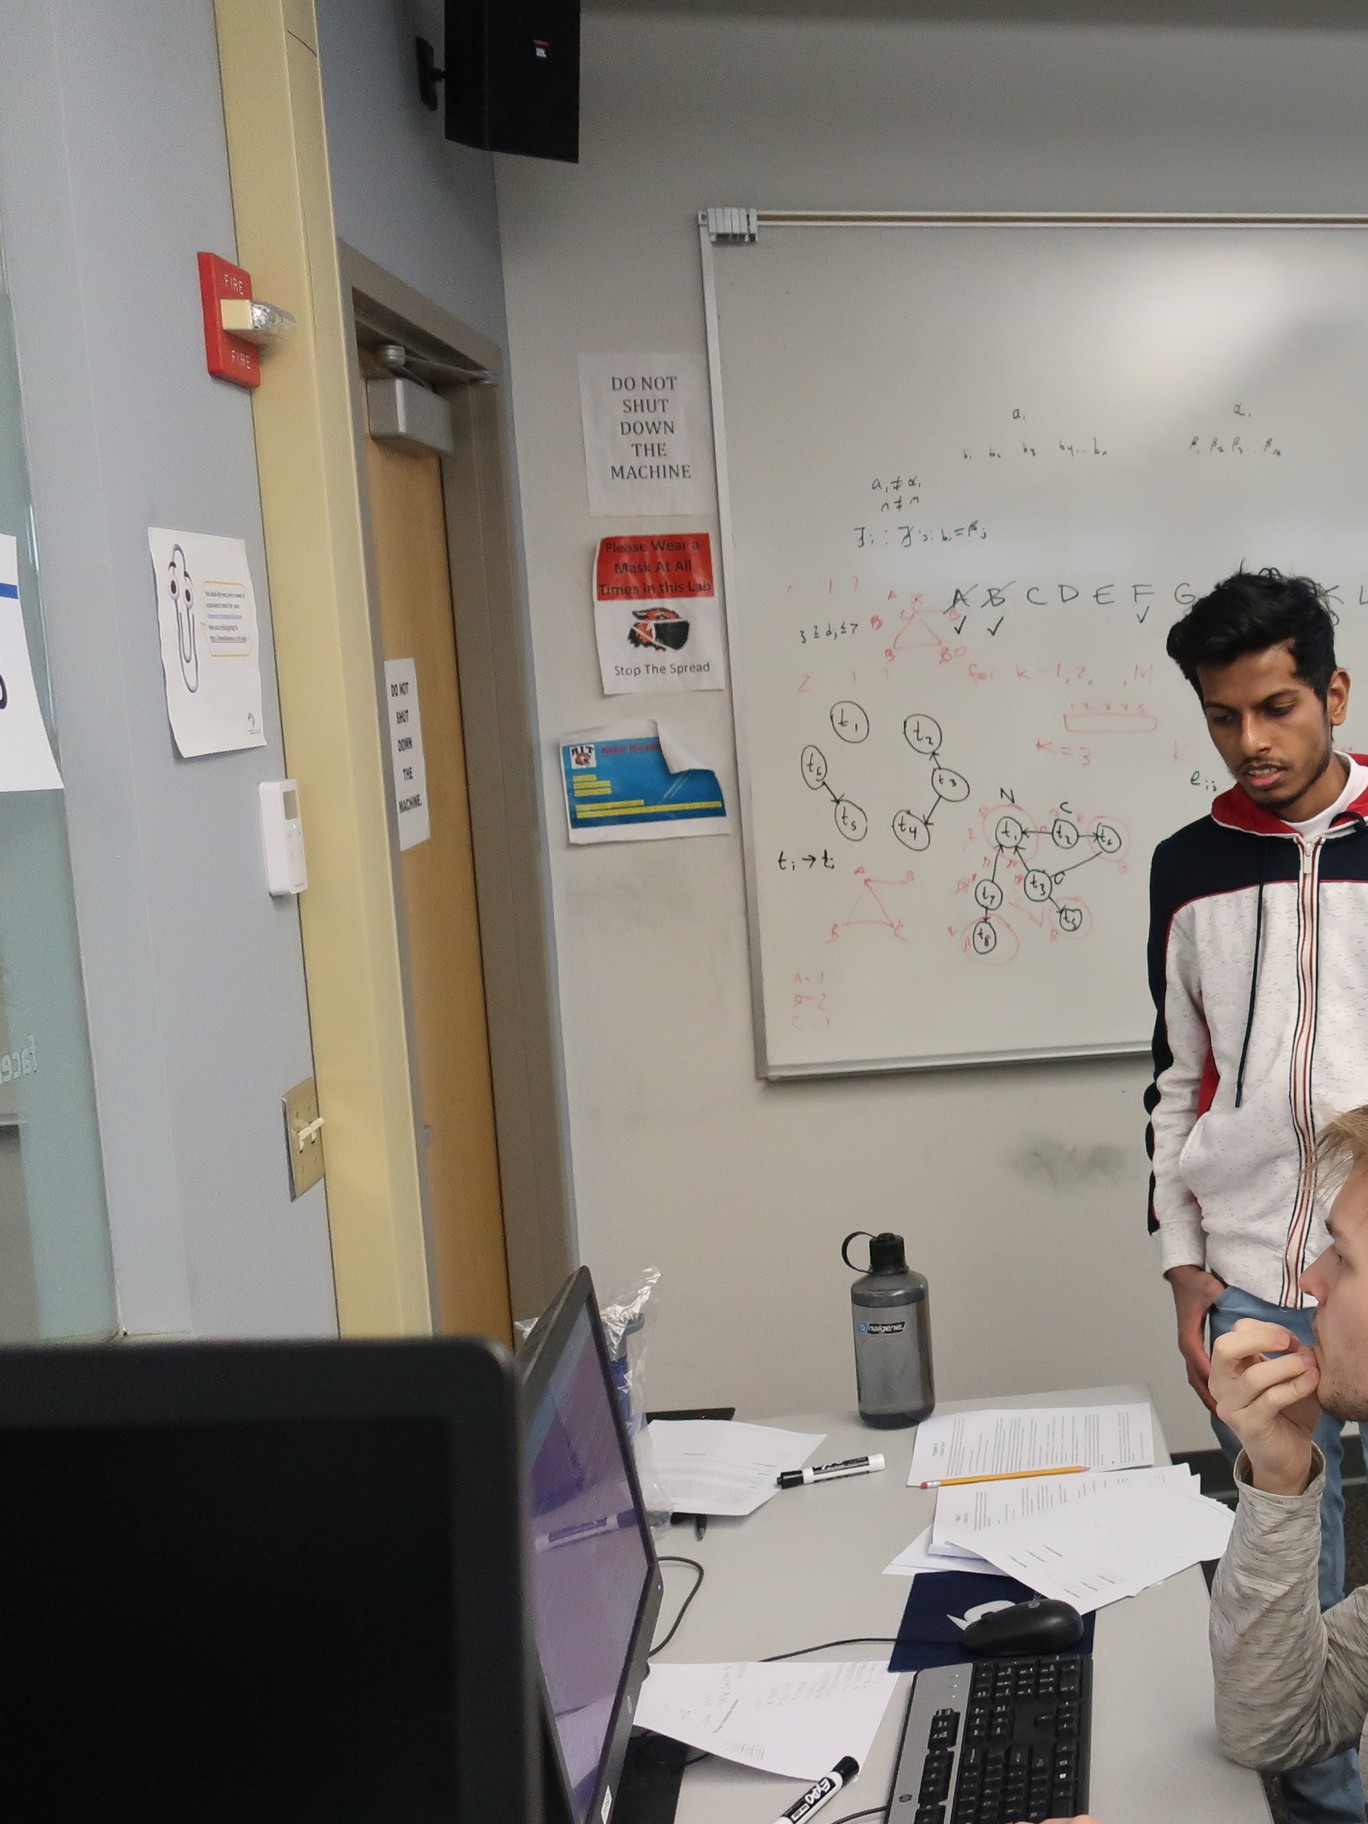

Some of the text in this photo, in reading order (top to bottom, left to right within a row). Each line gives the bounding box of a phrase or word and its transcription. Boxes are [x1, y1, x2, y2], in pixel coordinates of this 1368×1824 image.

[224, 274, 244, 296] FIRE
[231, 350, 251, 370] FIRE
[611, 375, 678, 391] DO NOT
[622, 398, 669, 414] SHUT
[620, 421, 675, 436] DOWN
[631, 442, 667, 457] THE
[611, 464, 692, 480] MACHINE
[606, 540, 700, 554] Please Wear a
[614, 559, 692, 574] Mask At All
[600, 580, 712, 596] Times in this Lab
[1026, 586, 1048, 606] C
[1058, 584, 1079, 603] D
[1093, 584, 1114, 605] E
[1132, 583, 1155, 602] F
[614, 662, 711, 678] Stop The Spread
[398, 682, 410, 696] NOT
[395, 709, 409, 724] SHUT
[397, 737, 413, 752] DOWN
[402, 767, 414, 781] THE
[398, 794, 422, 814] MACHINE
